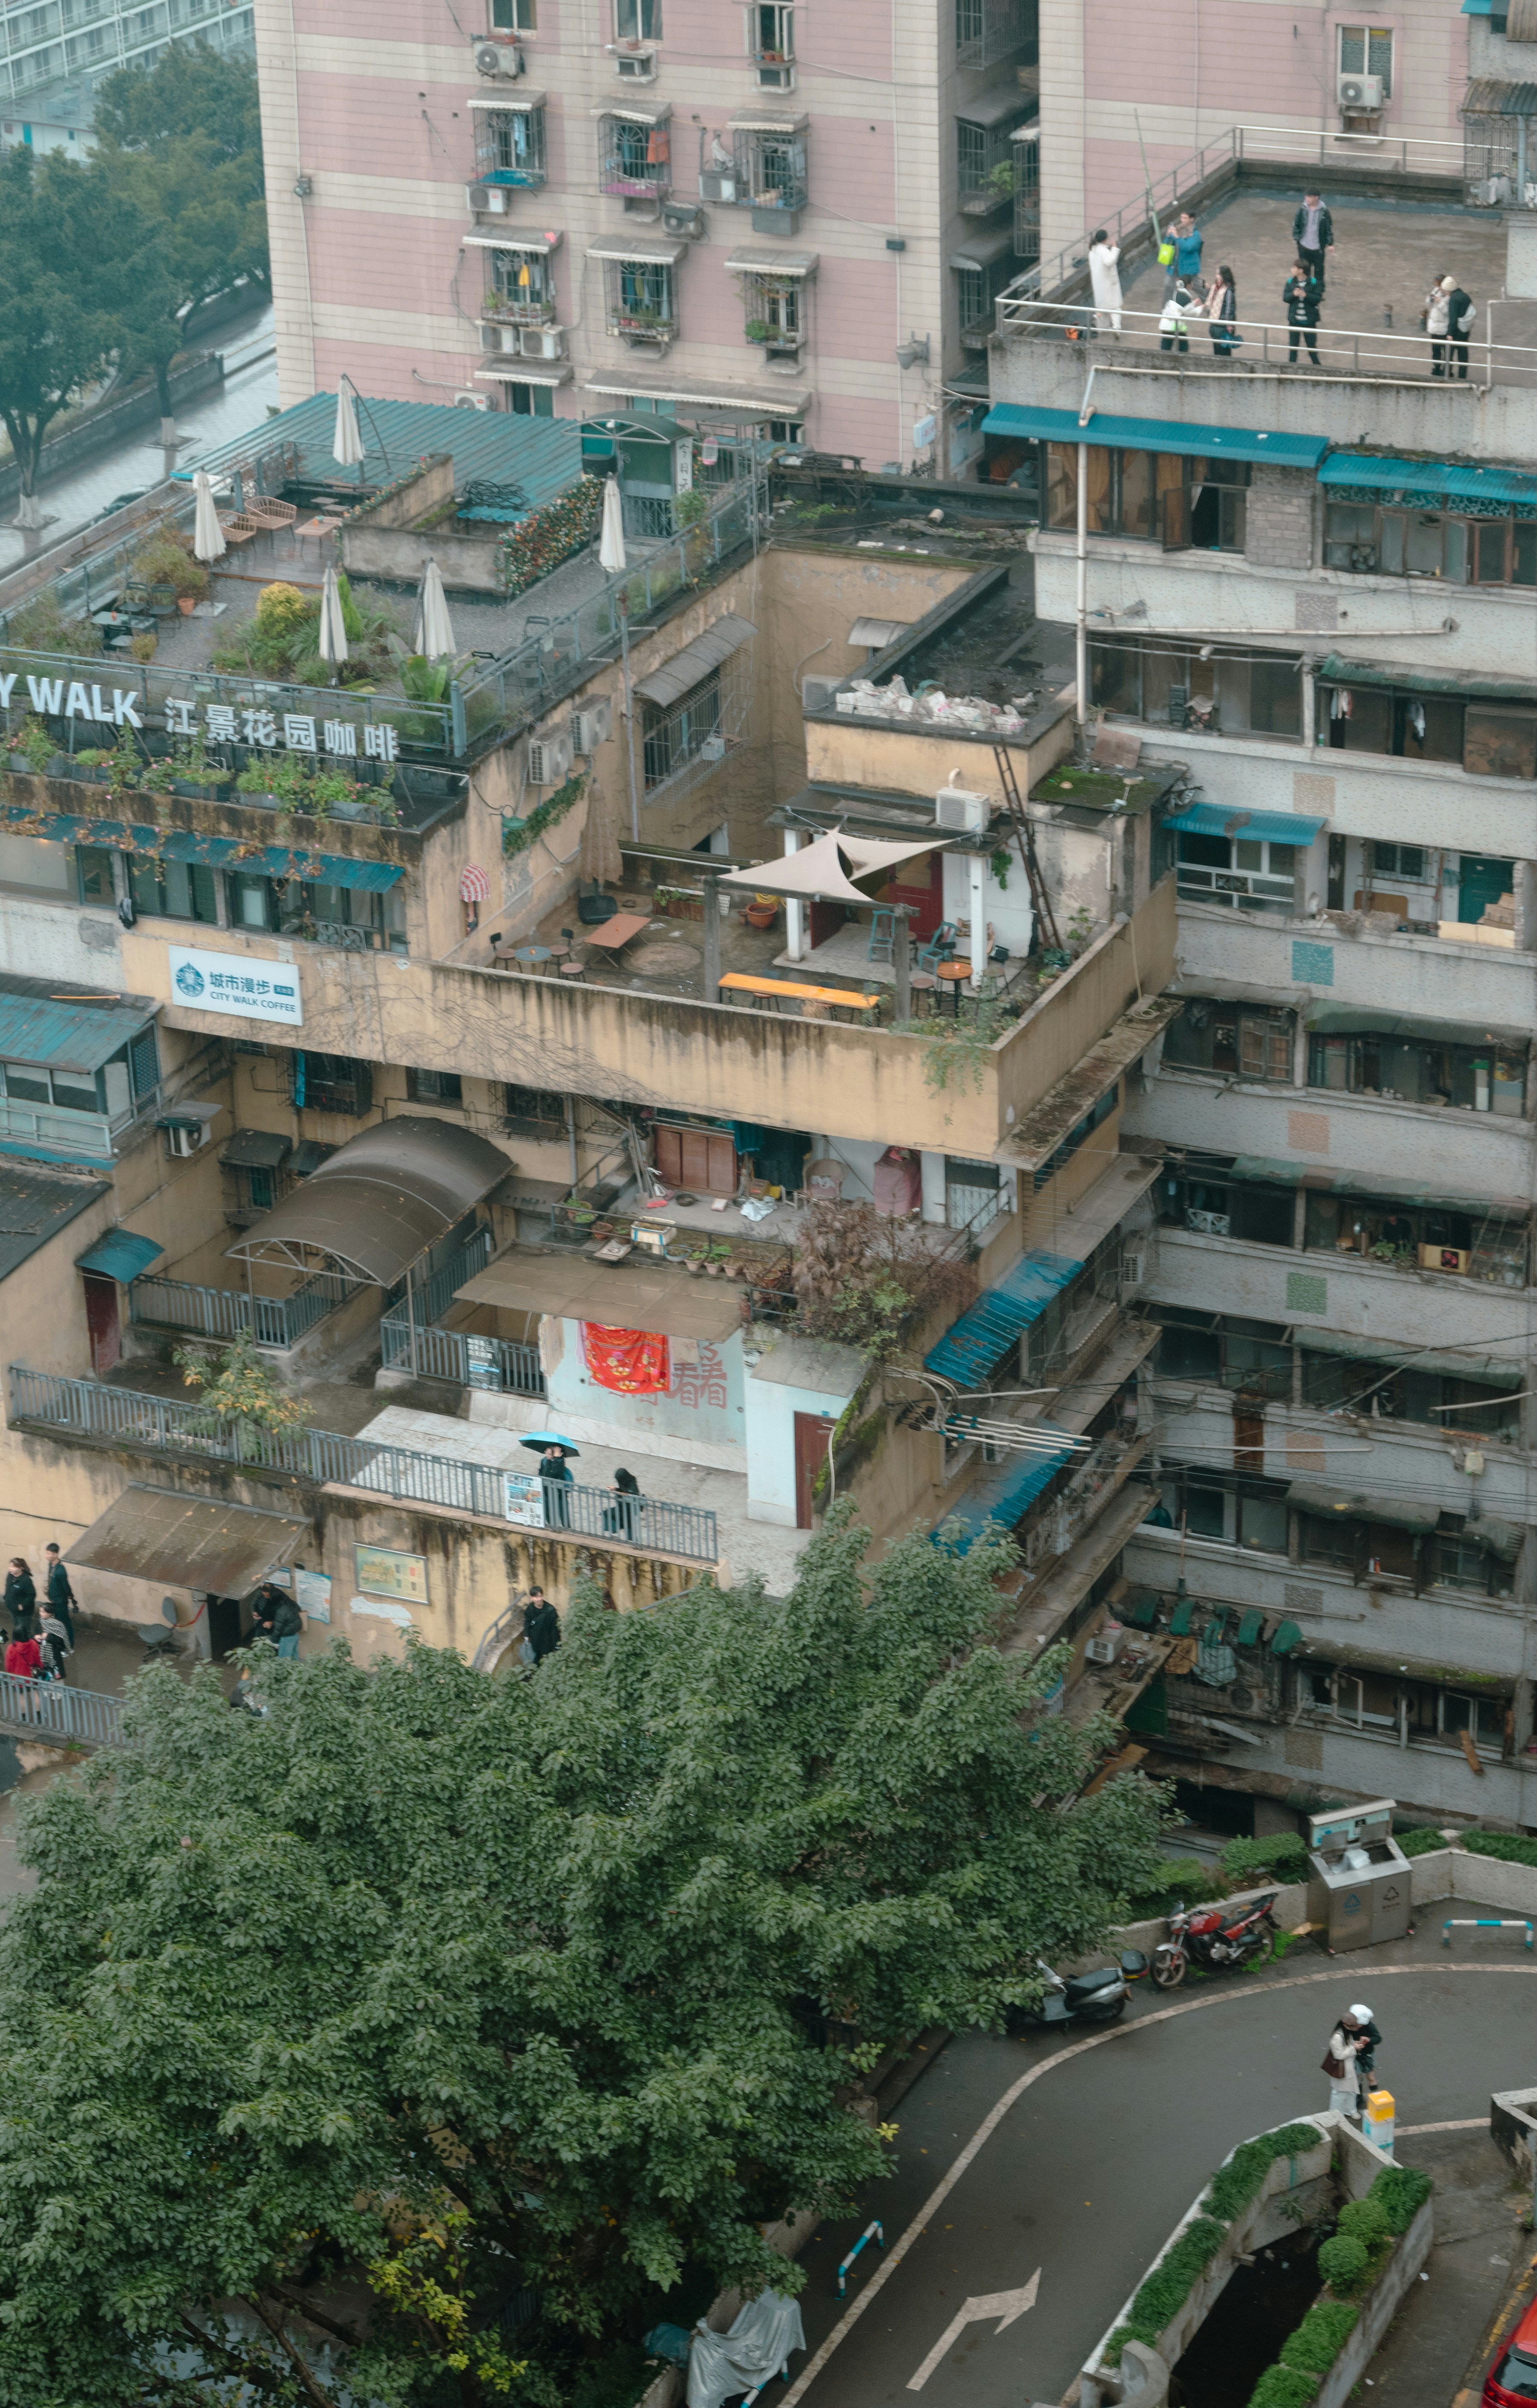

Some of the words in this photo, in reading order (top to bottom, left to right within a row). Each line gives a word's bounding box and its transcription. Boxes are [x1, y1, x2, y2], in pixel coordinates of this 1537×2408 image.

[26, 675, 143, 728] WALK
[164, 697, 400, 762] 江景花园咖啡
[210, 971, 270, 995] 城市漫步
[210, 991, 231, 1001] CITY
[233, 995, 259, 1007] WALK
[261, 999, 296, 1013] COFFEE
